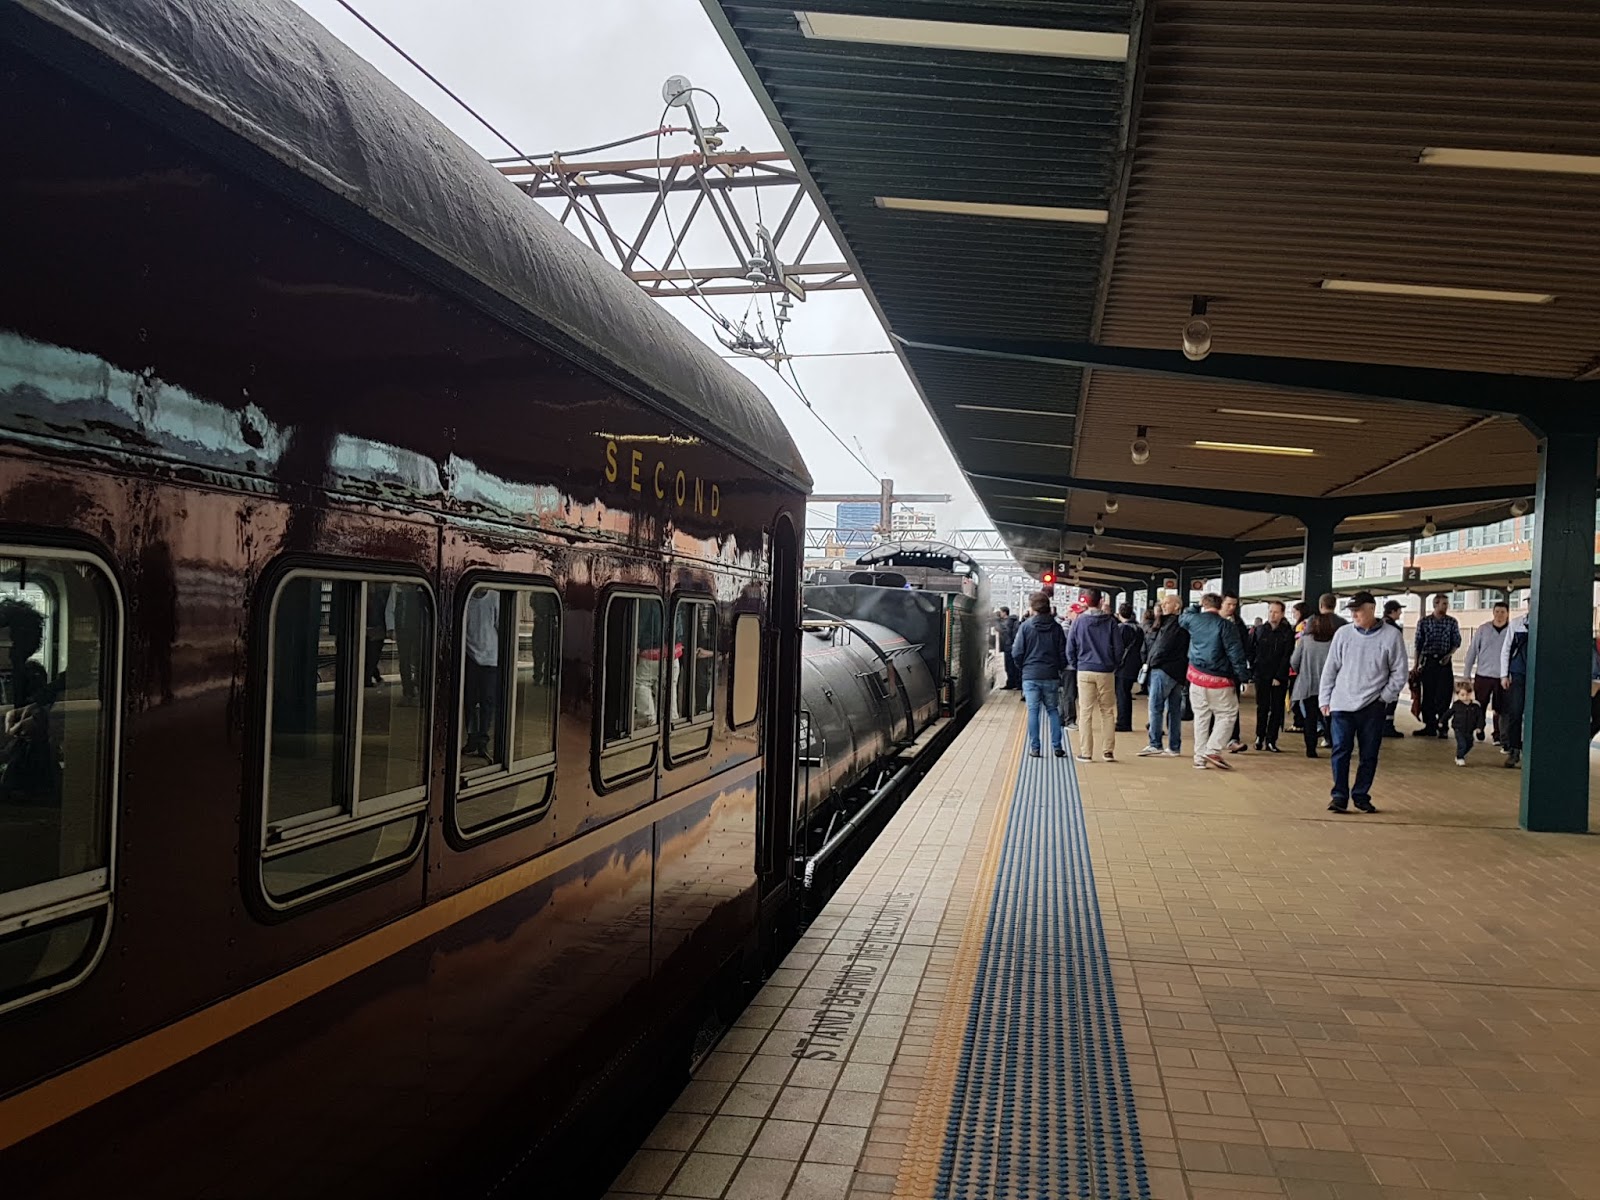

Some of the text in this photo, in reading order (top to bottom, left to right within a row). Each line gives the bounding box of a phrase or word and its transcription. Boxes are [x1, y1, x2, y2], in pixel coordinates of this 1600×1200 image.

[604, 440, 720, 517] SECOND
[1058, 563, 1065, 573] 3
[1408, 569, 1416, 579] 2
[861, 908, 907, 941] YELLOW
[846, 942, 889, 962] THE
[820, 964, 878, 1008] BEHIND
[791, 1009, 856, 1061] STAND
